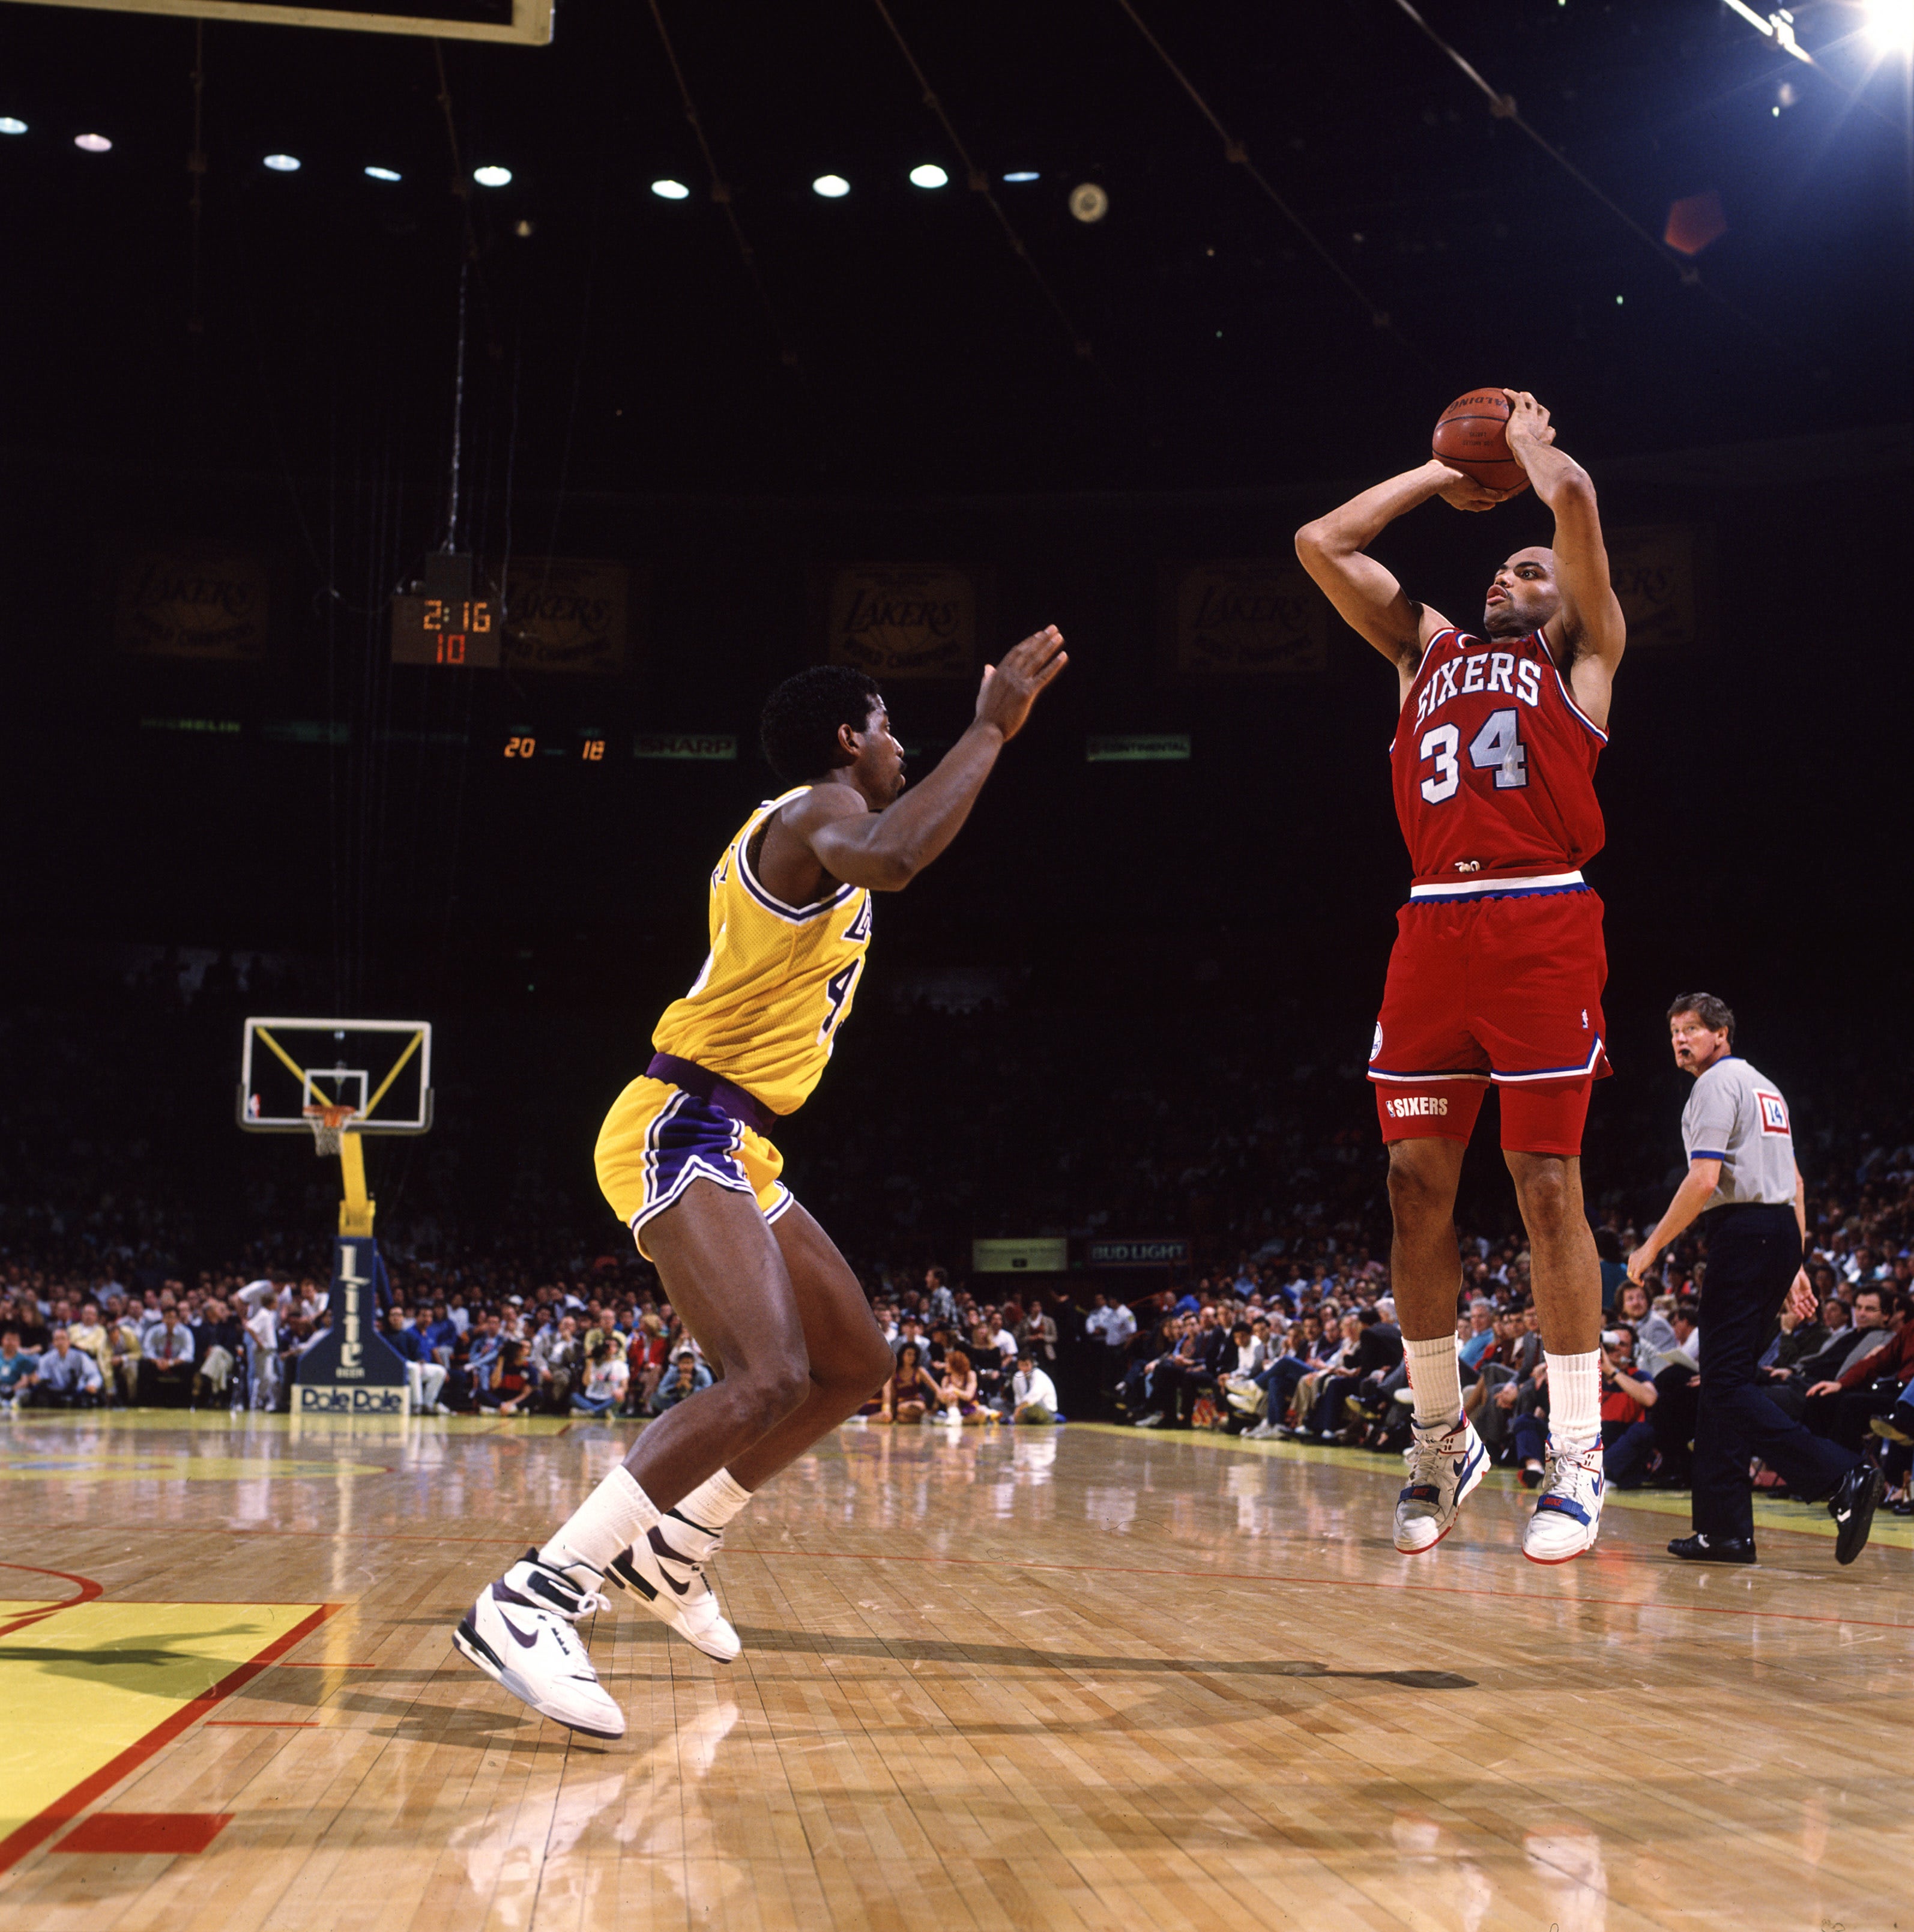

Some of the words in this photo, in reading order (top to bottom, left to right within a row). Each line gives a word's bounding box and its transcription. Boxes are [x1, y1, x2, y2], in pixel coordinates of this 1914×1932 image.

[423, 600, 491, 633] 2:16
[843, 588, 960, 637] LAKERS
[436, 633, 466, 664] 10
[1413, 652, 1542, 736] SIXERS
[504, 737, 536, 758] 20
[582, 740, 606, 761] 18
[639, 737, 732, 755] SHARP
[1420, 707, 1529, 806] 34
[1393, 1097, 1448, 1117] SIXERS
[1768, 1101, 1783, 1124] 14
[1091, 1244, 1129, 1260] BUD
[1131, 1244, 1186, 1260] LIGHT
[339, 1245, 371, 1368] Lite
[301, 1388, 350, 1408] Dole
[353, 1388, 402, 1408] Dole
[1412, 1488, 1430, 1496] NIKE
[1543, 1497, 1564, 1506] NIKE
